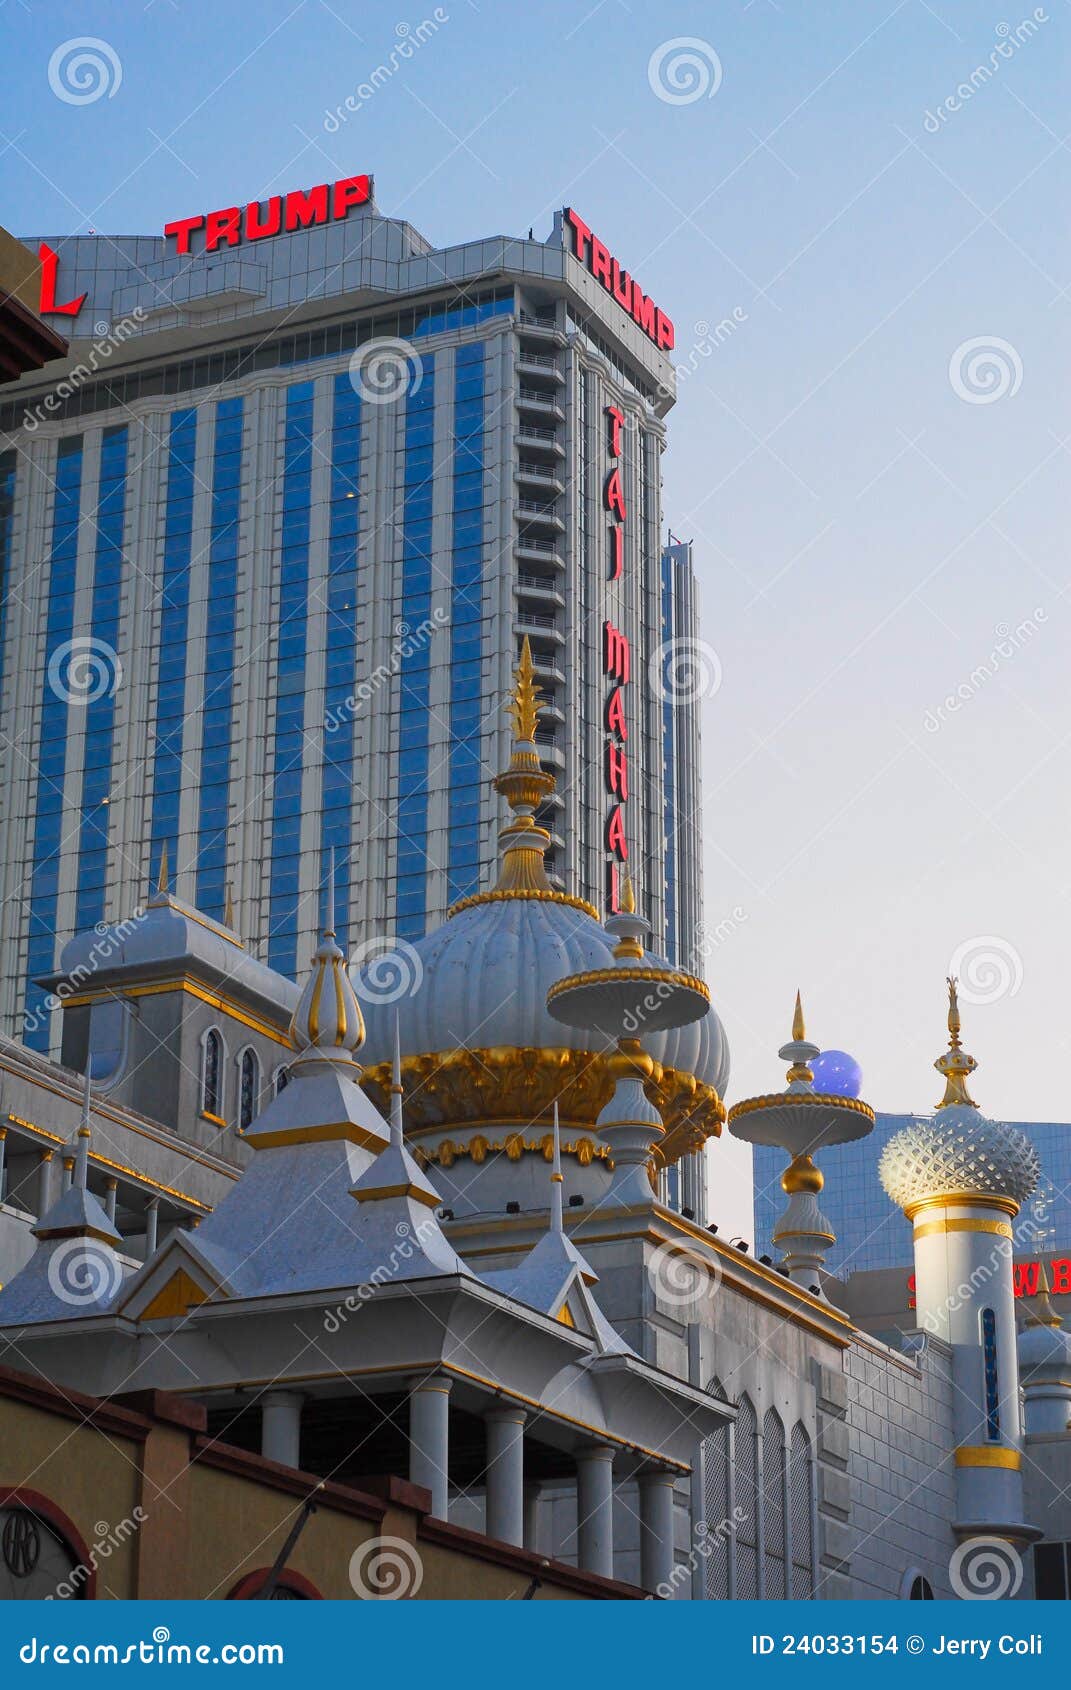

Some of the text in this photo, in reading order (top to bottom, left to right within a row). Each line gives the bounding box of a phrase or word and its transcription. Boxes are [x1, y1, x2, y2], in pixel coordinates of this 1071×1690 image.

[164, 174, 372, 255] TRUMP
[565, 206, 675, 350] TRUMP
[603, 405, 630, 915] TAJ MAHAL
